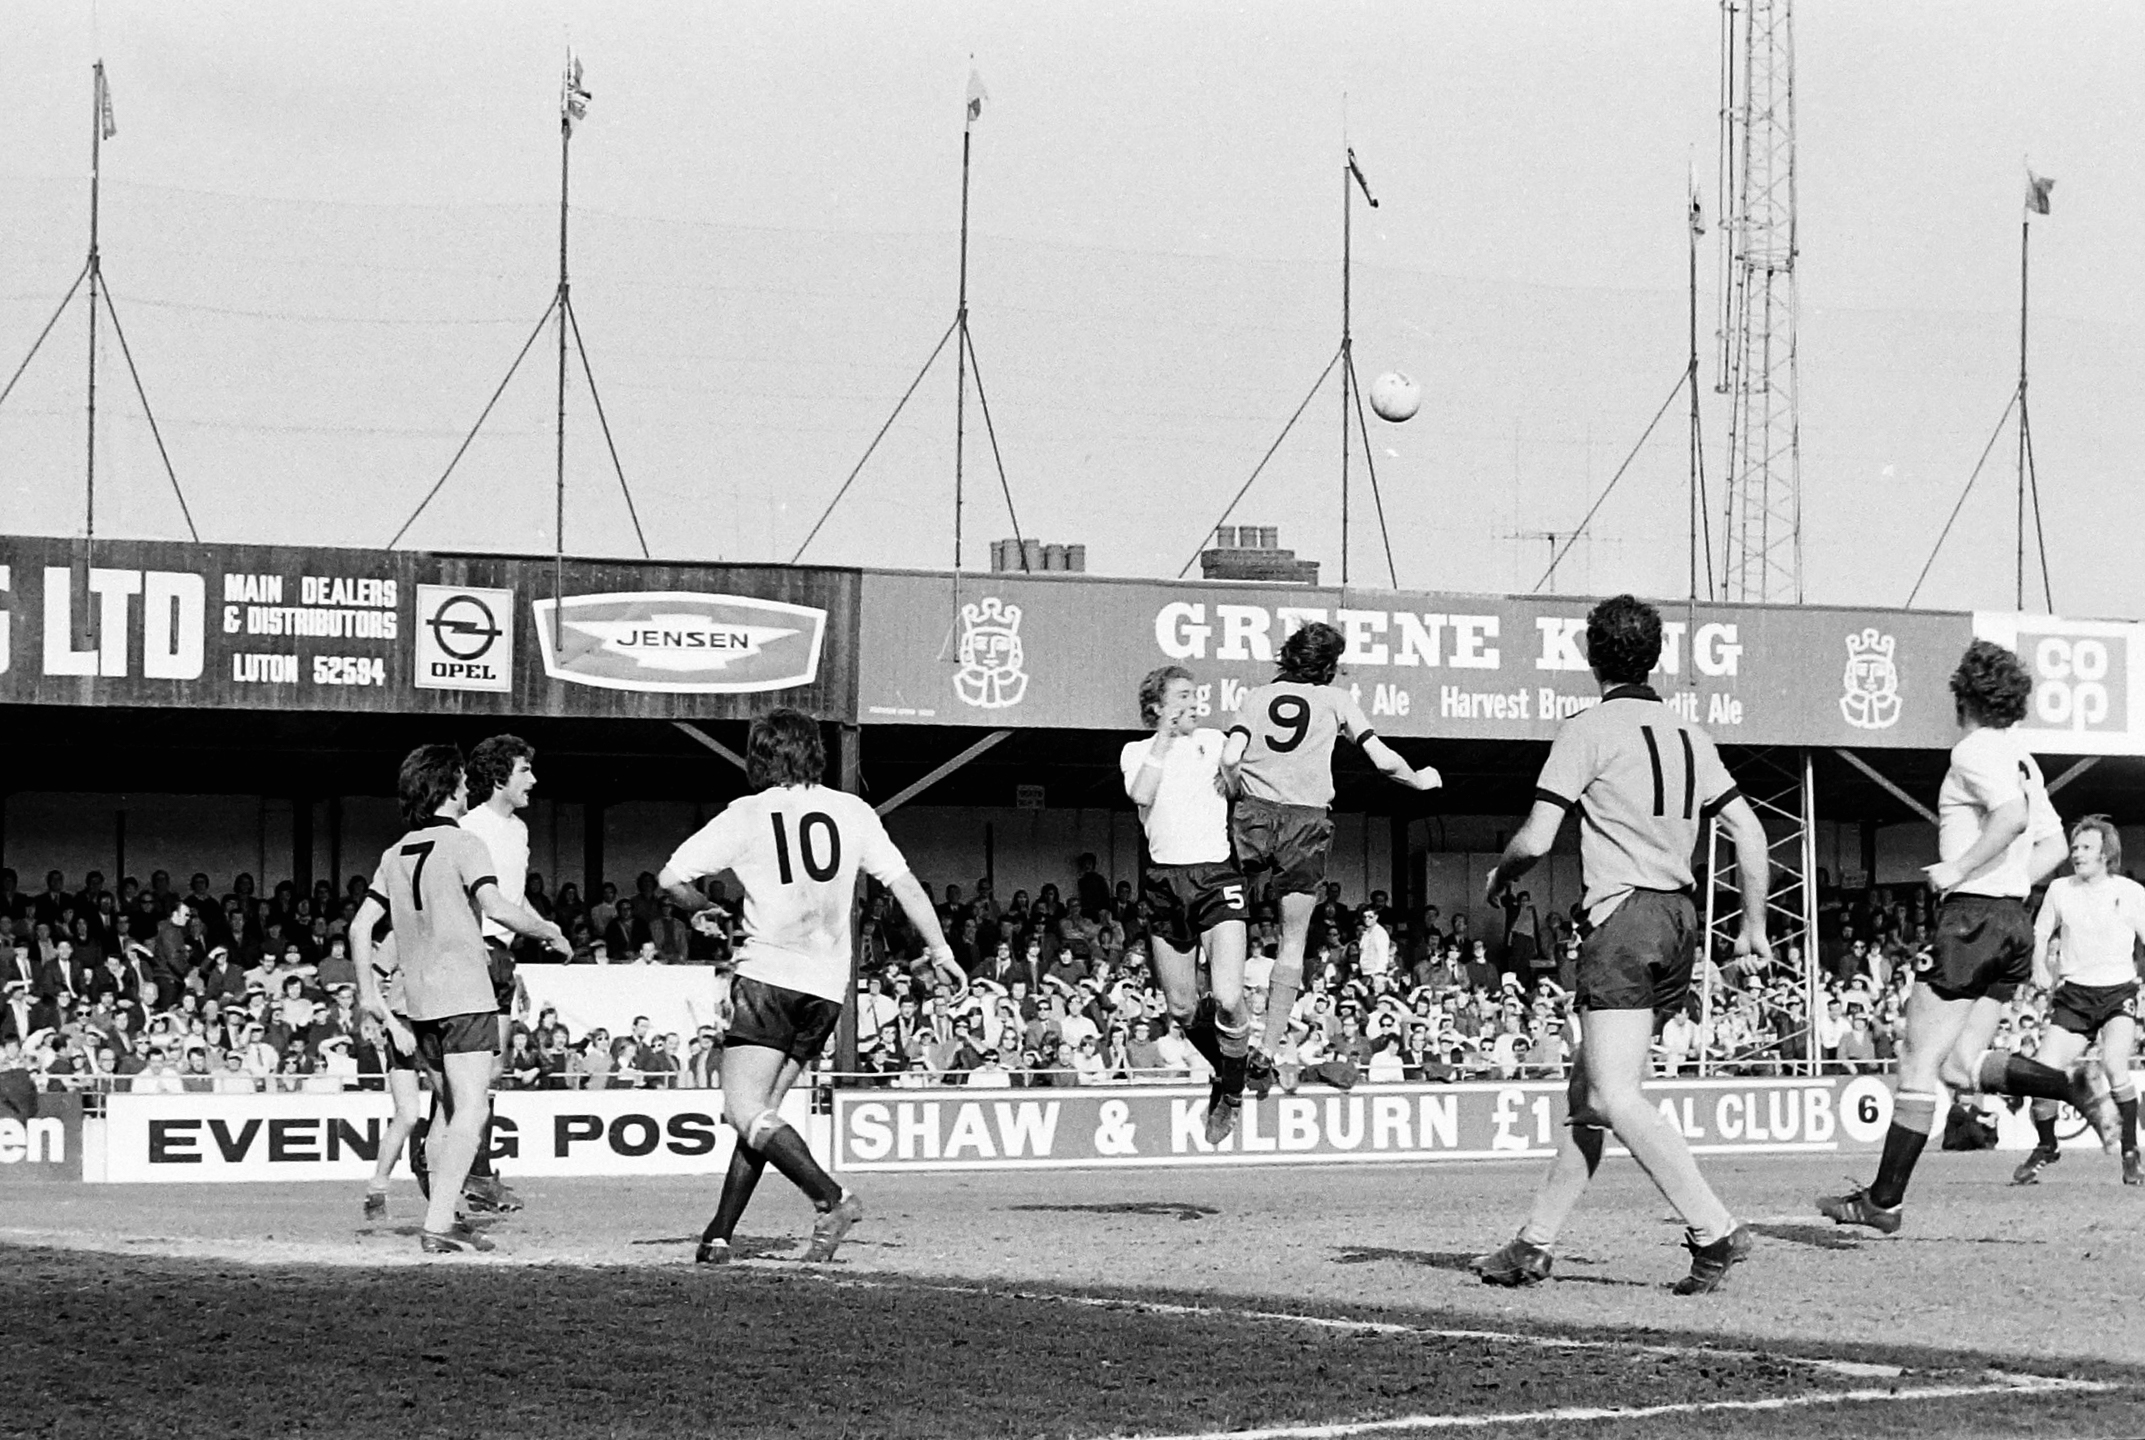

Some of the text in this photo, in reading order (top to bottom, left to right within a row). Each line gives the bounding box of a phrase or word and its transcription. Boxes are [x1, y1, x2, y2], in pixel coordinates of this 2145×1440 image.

[224, 573, 398, 608] MAIN DEALERS
[43, 566, 205, 679] LTD
[223, 606, 398, 639] & DISTRIBUTORS
[616, 630, 749, 648] JENSEN
[233, 653, 386, 686] LUTON 52594
[431, 662, 496, 679] OPEL
[1372, 684, 1410, 716] Ale
[1441, 686, 1530, 719] Harvest
[1707, 693, 1744, 724] Ale
[1264, 695, 1310, 753] 9
[1640, 725, 1695, 819] 11
[771, 811, 841, 885] 10
[400, 840, 436, 911] 7
[1223, 885, 1245, 909] 5
[554, 1112, 727, 1158] POS
[850, 1101, 1060, 1160] SHAW
[1095, 1099, 1136, 1154] &
[1716, 1087, 1836, 1142] CLUB
[1857, 1094, 1879, 1124] 6
